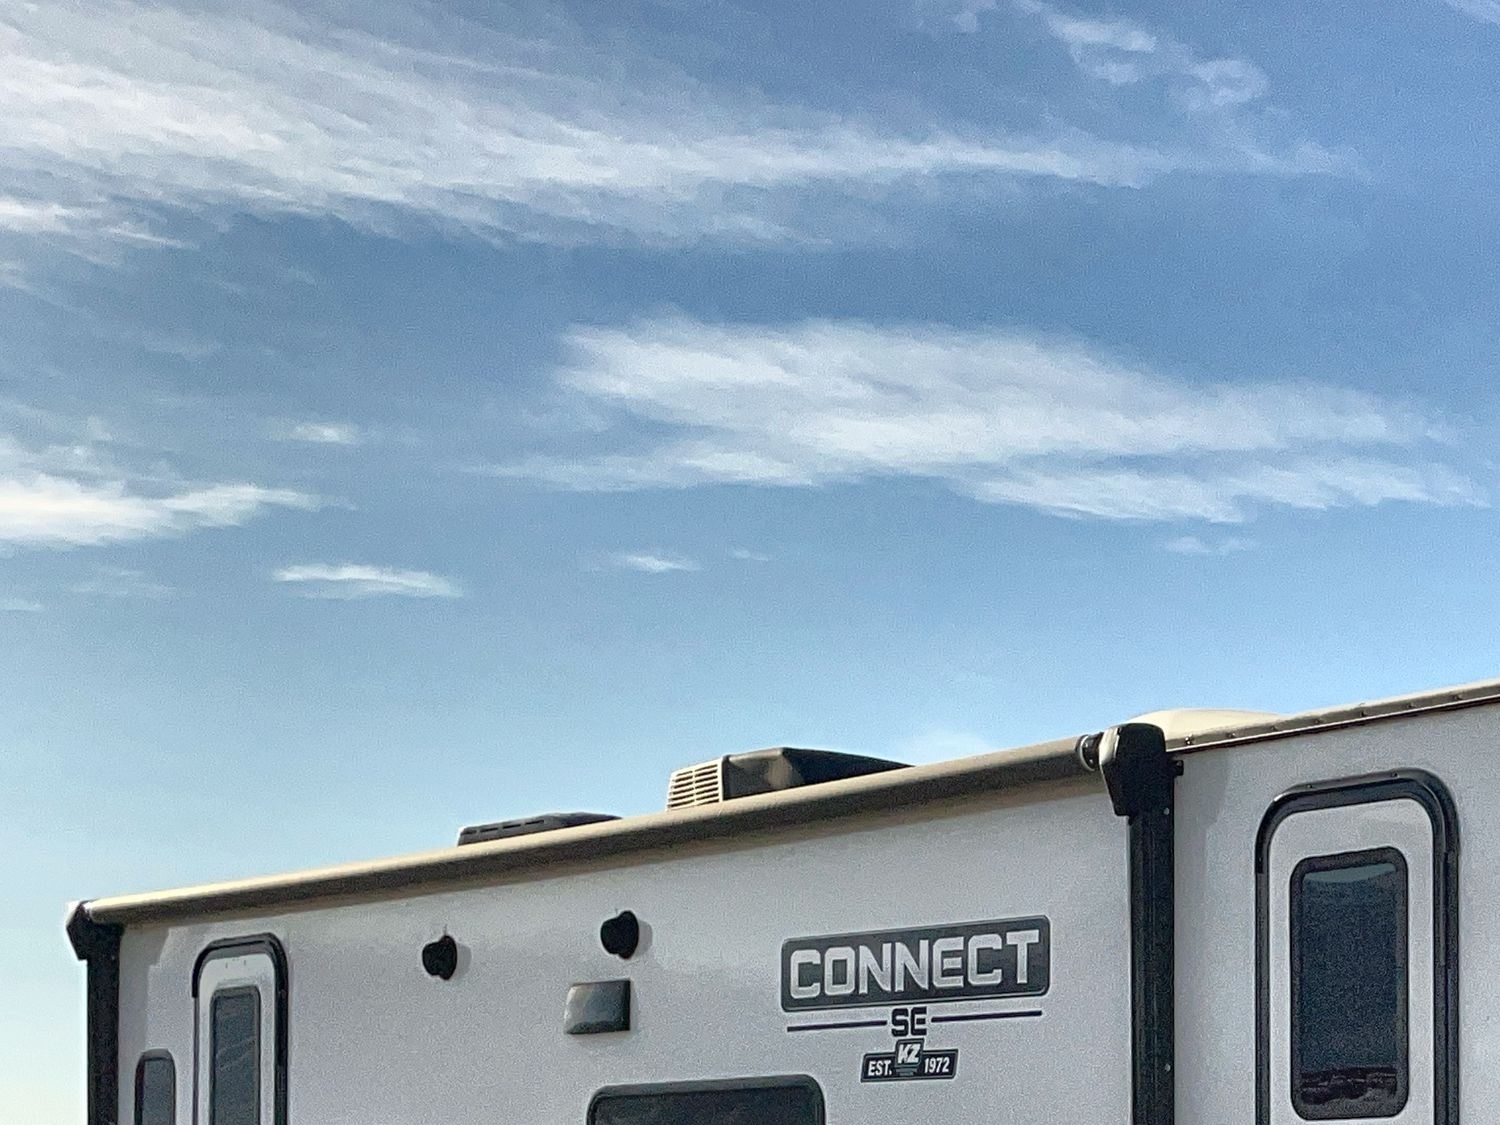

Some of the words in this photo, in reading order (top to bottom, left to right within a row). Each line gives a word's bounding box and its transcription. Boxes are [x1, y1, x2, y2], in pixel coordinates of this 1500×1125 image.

[789, 929, 1041, 1000] CONNECT
[890, 1006, 928, 1037] SE
[867, 1059, 893, 1077] EST.
[897, 1043, 922, 1065] KZ
[923, 1056, 951, 1074] 1972
